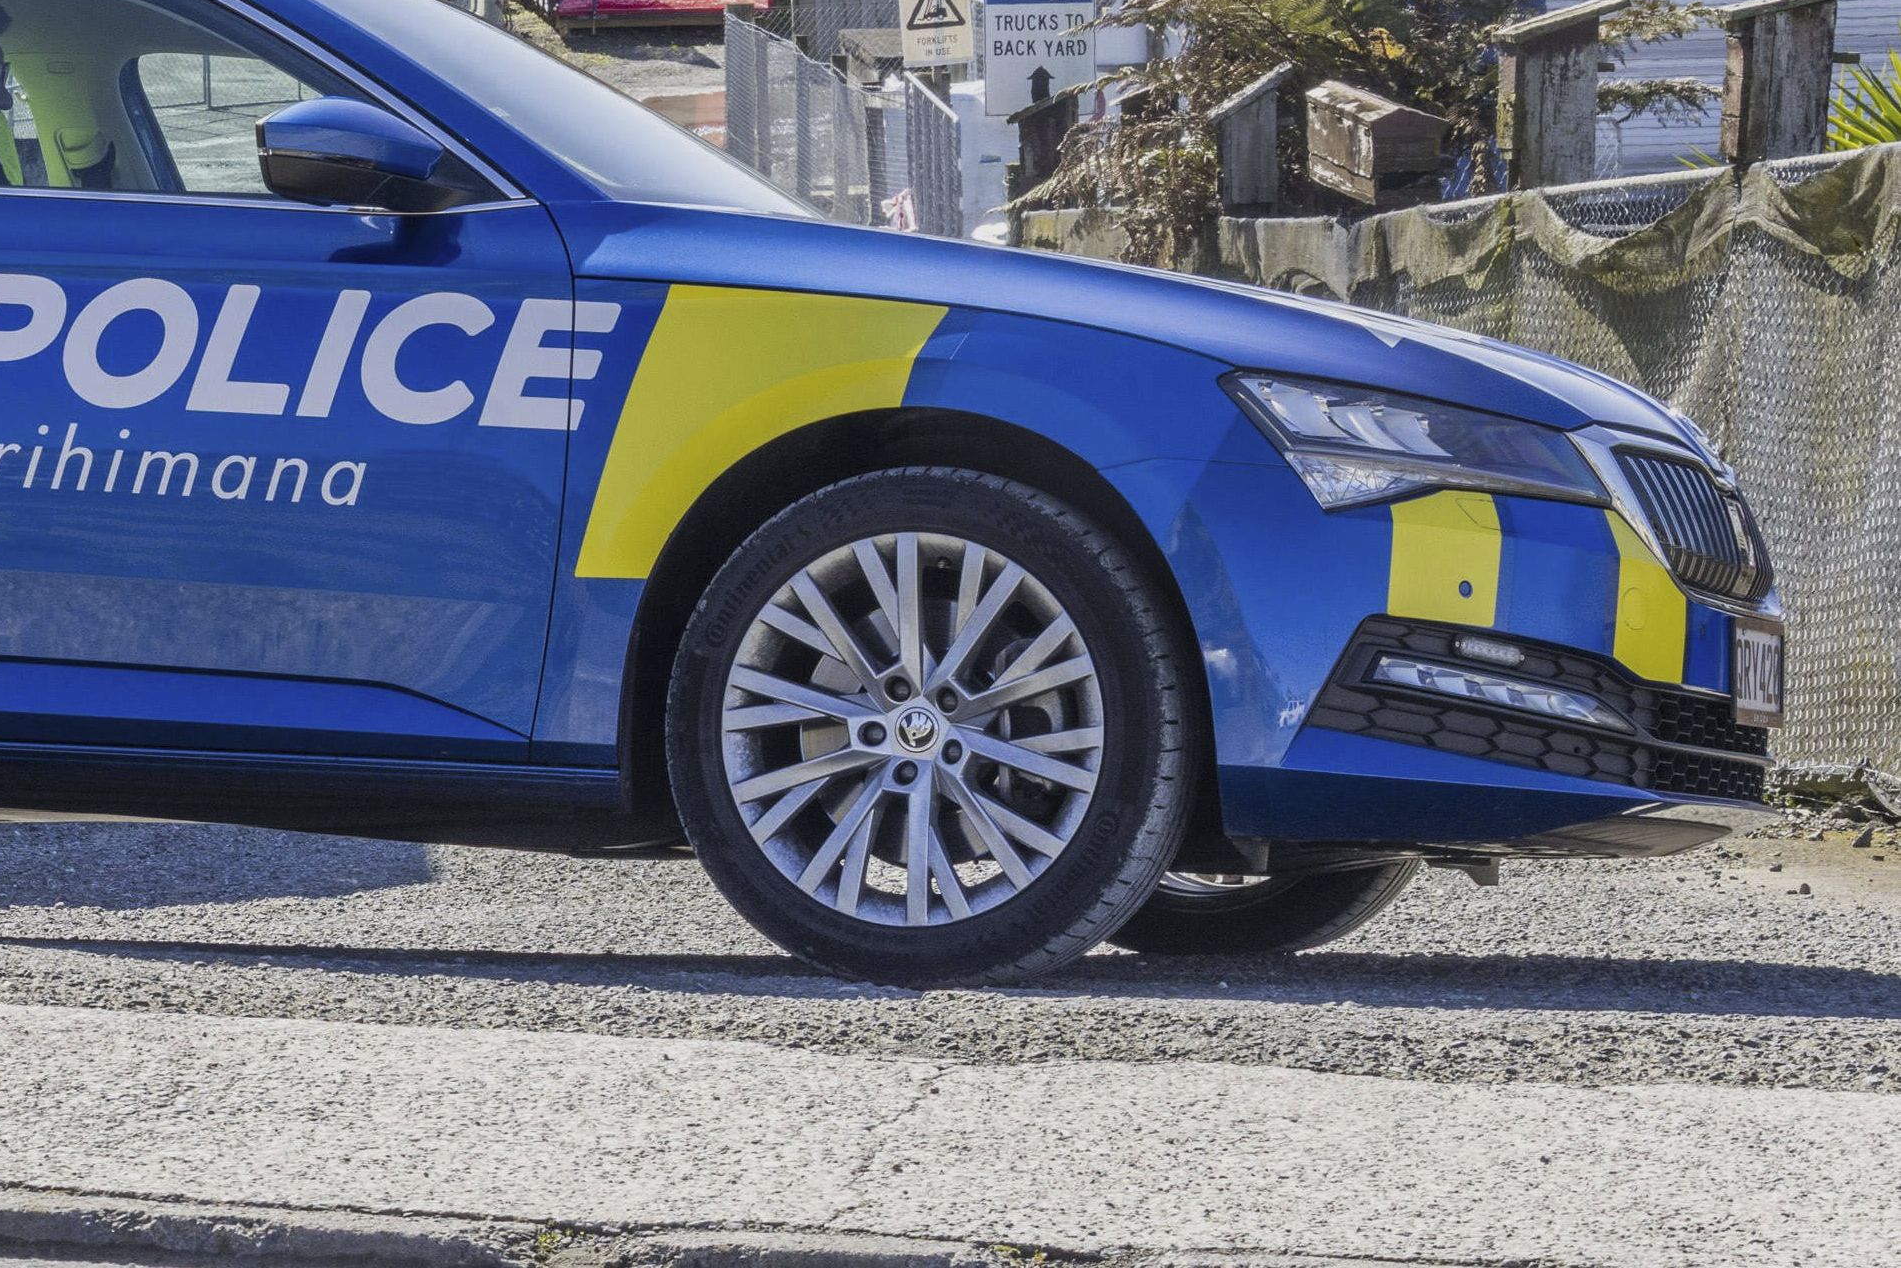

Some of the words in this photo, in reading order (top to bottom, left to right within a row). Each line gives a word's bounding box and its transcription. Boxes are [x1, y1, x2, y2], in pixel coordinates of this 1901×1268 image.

[995, 14, 1058, 31] TRUCKS
[1064, 13, 1084, 29] TO
[917, 34, 958, 45] FORKLIFTS
[925, 48, 933, 56] IN
[935, 47, 951, 56] USE
[993, 39, 1036, 56] BACK
[1044, 39, 1087, 57] YARD
